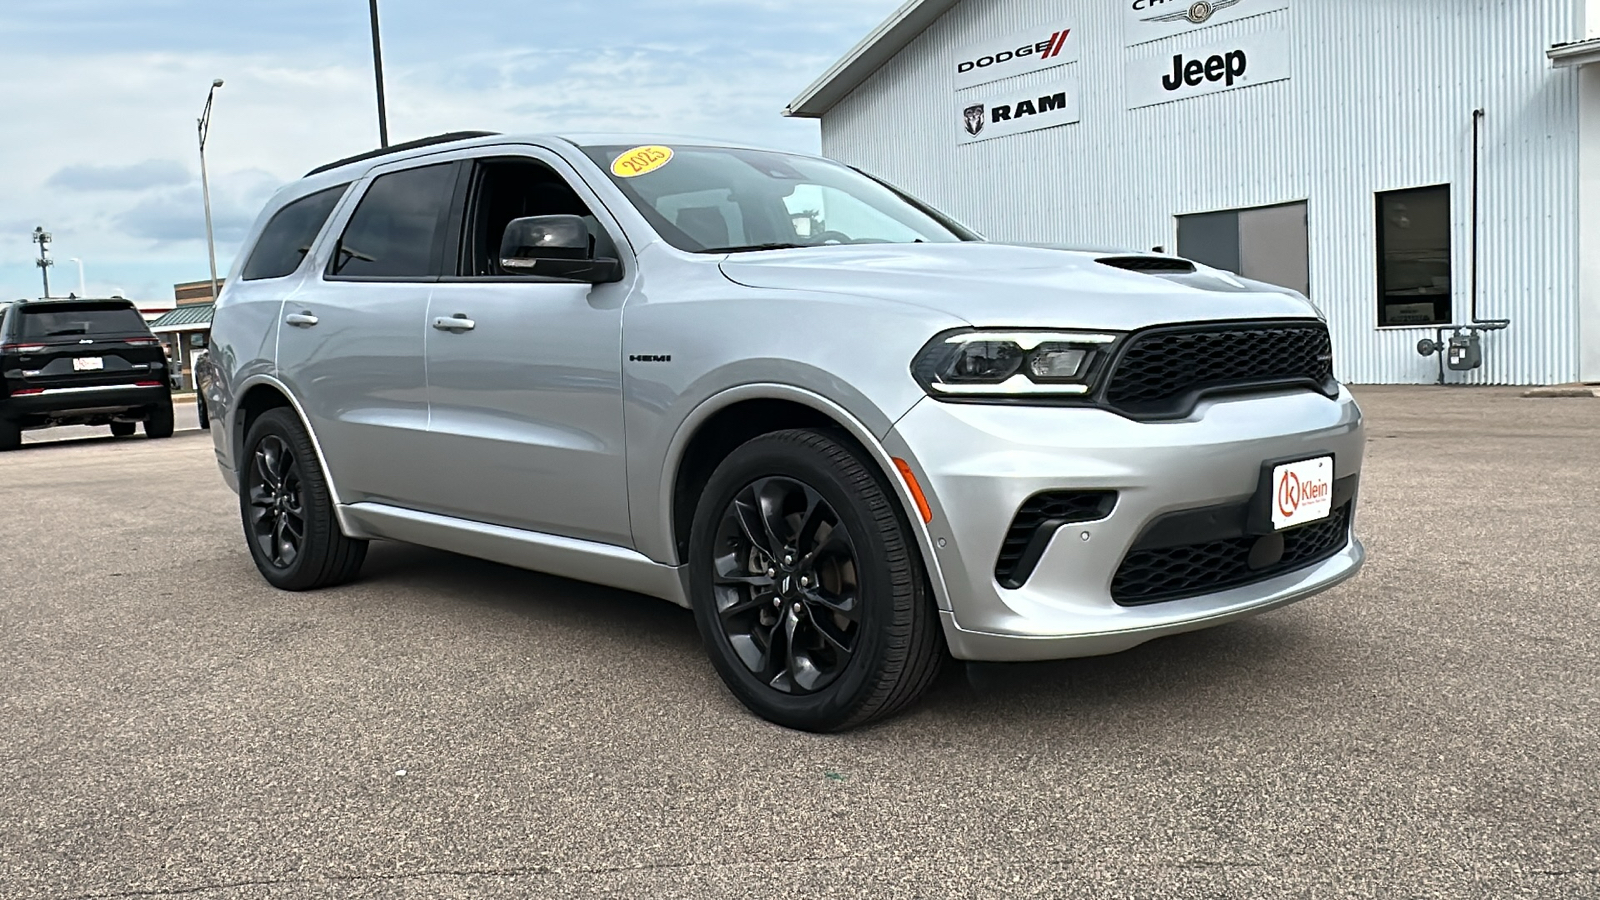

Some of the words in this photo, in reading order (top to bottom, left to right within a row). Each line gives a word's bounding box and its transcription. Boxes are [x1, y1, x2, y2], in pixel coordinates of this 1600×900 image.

[957, 40, 1052, 74] DODGE
[1162, 49, 1247, 91] Jeep
[991, 92, 1066, 123] RAM
[622, 148, 665, 172] 2025
[1301, 479, 1327, 500] Klein
